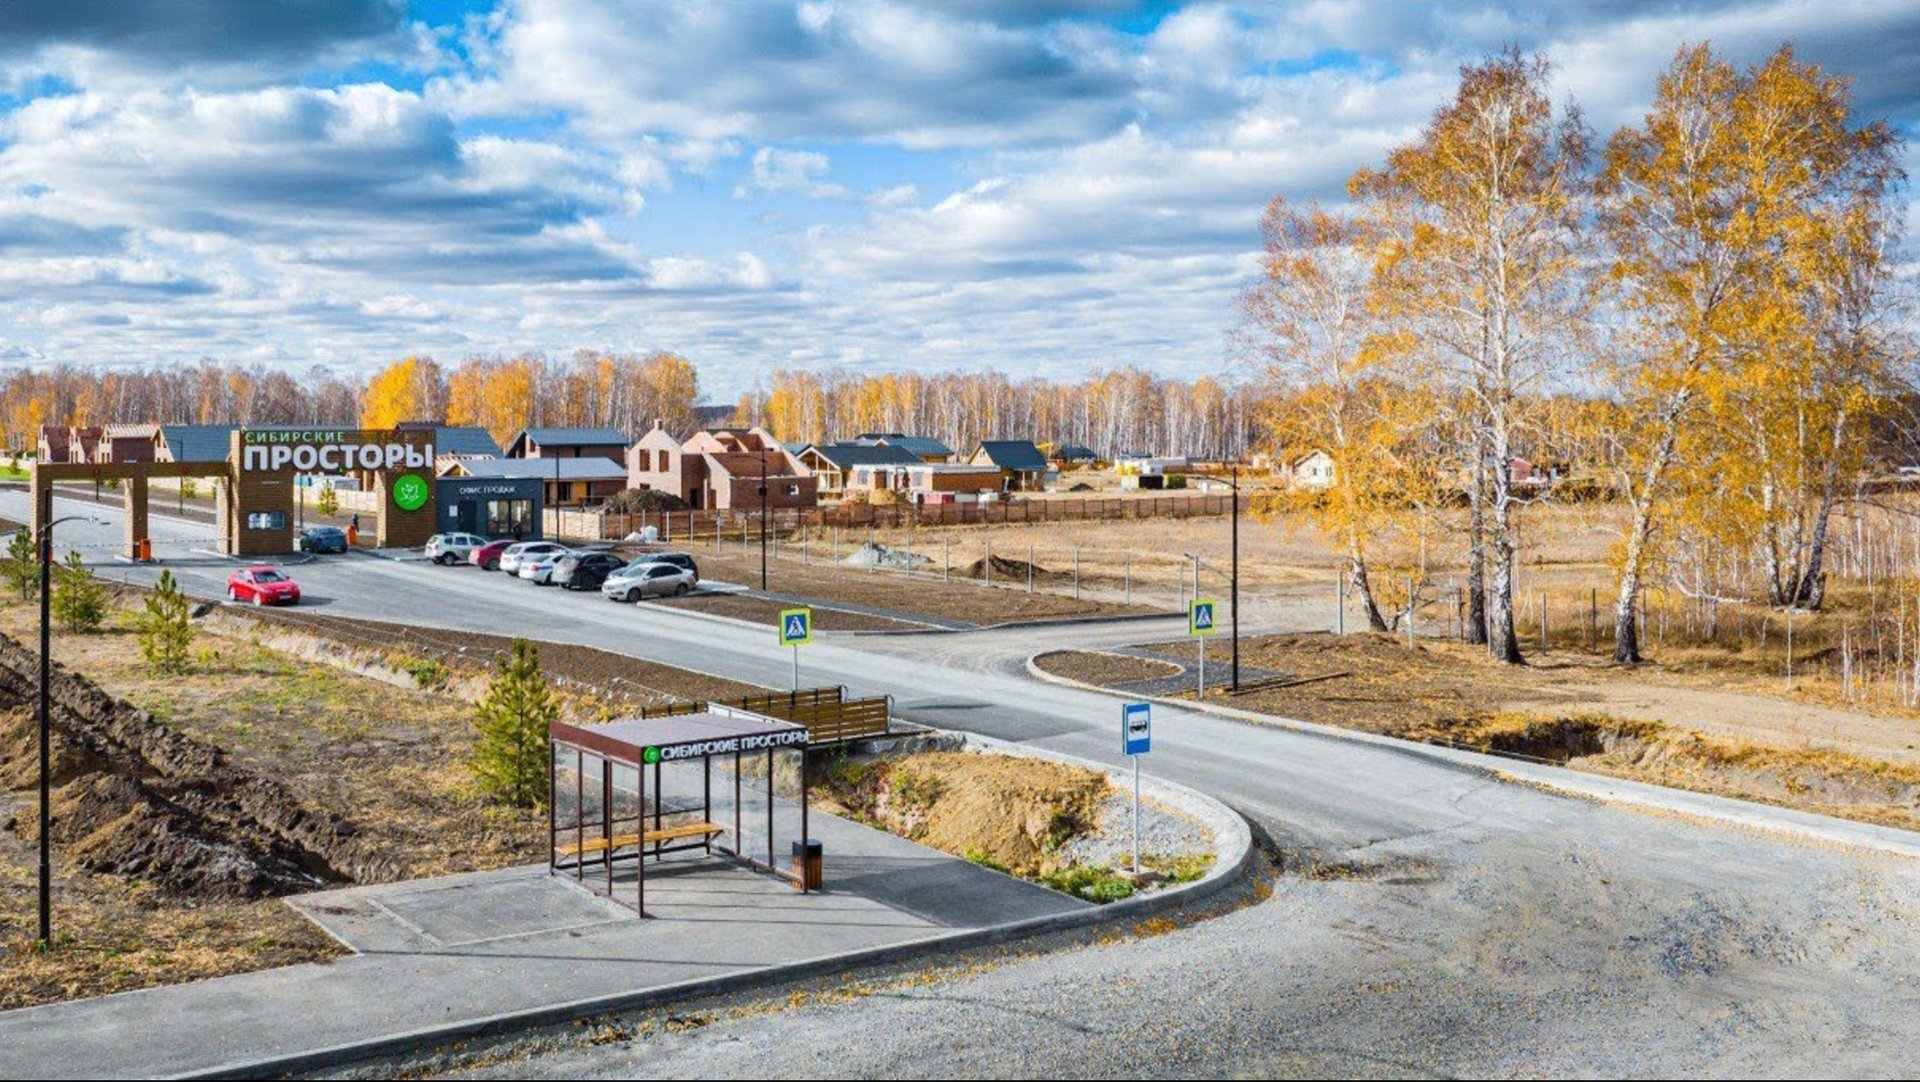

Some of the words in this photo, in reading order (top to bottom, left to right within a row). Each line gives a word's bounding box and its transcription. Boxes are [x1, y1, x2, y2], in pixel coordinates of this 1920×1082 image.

[245, 431, 345, 443] СИБИРСКИЕ
[244, 444, 433, 471] ПРОСТОРЫ
[661, 739, 739, 760] СИБИРСКИЕ
[741, 731, 810, 750] ПРОСТОРЫ
